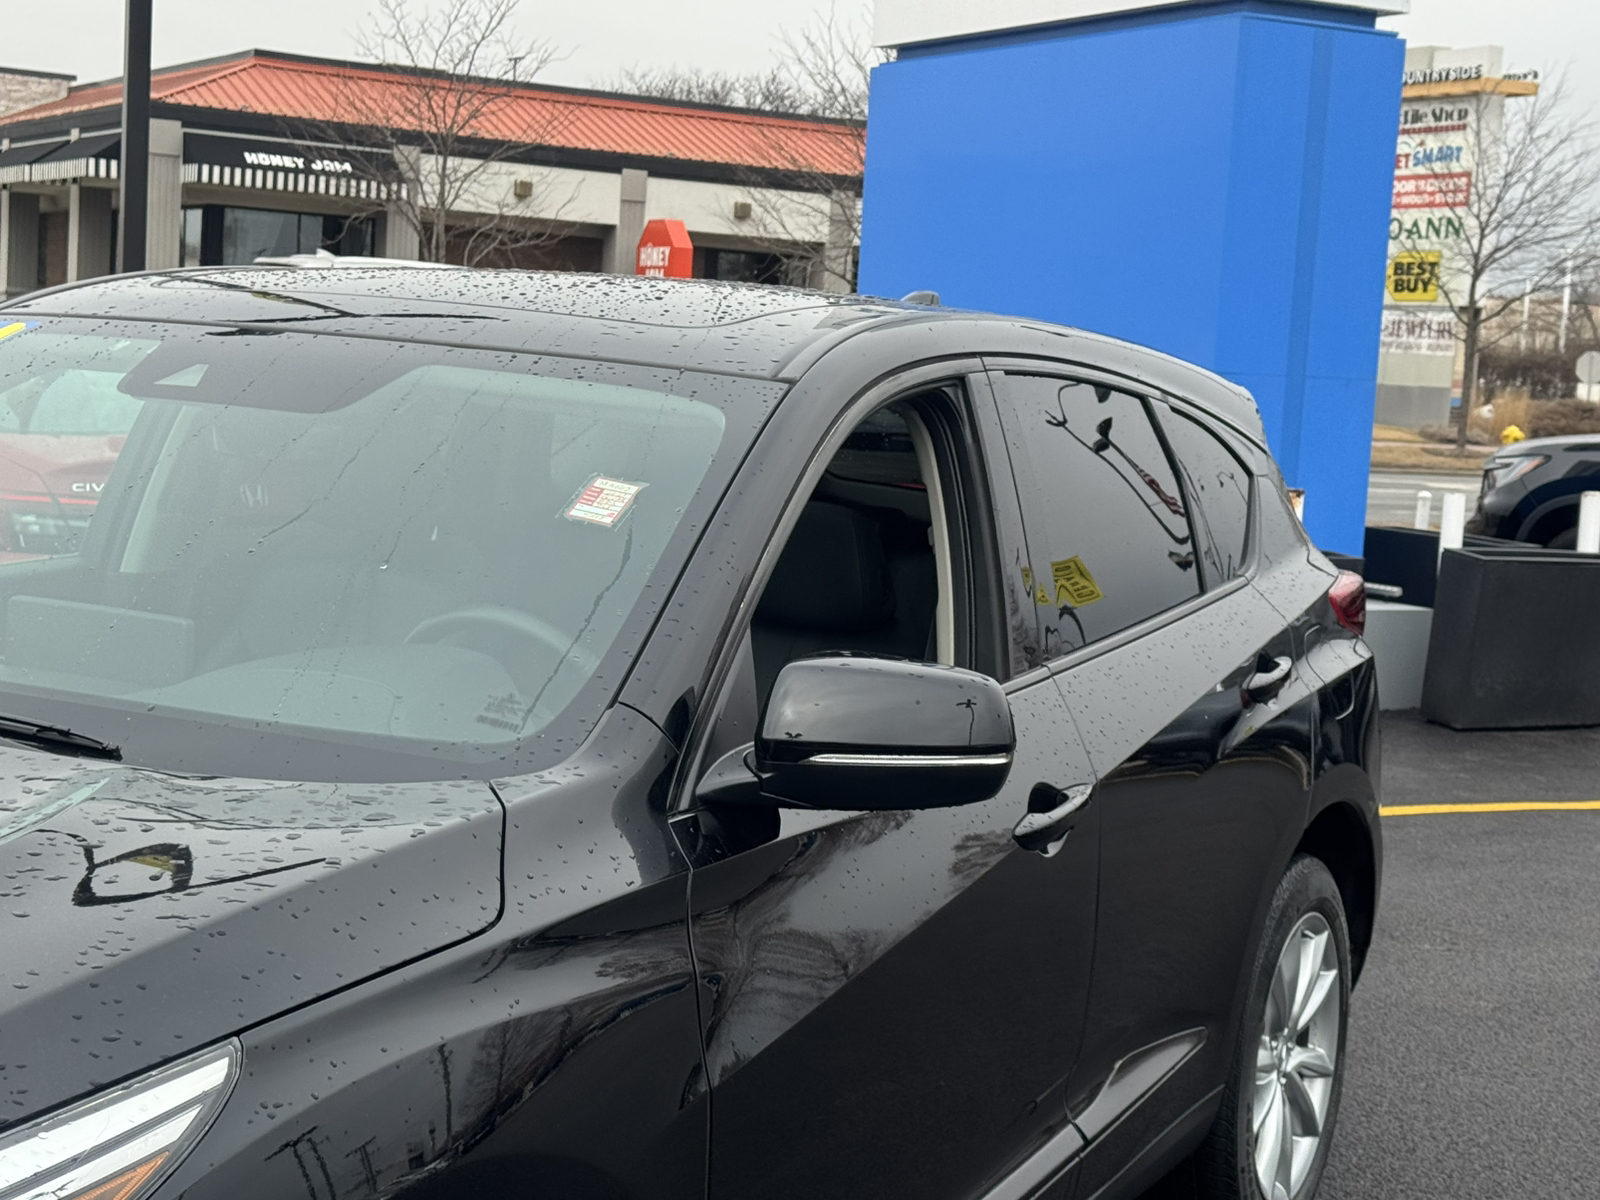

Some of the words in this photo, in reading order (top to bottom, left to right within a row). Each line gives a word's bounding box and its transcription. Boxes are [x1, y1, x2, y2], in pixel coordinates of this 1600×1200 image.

[243, 151, 305, 169] HONEY
[310, 159, 353, 174] JAM
[1393, 261, 1439, 276] BEST
[1393, 277, 1432, 293] BUY
